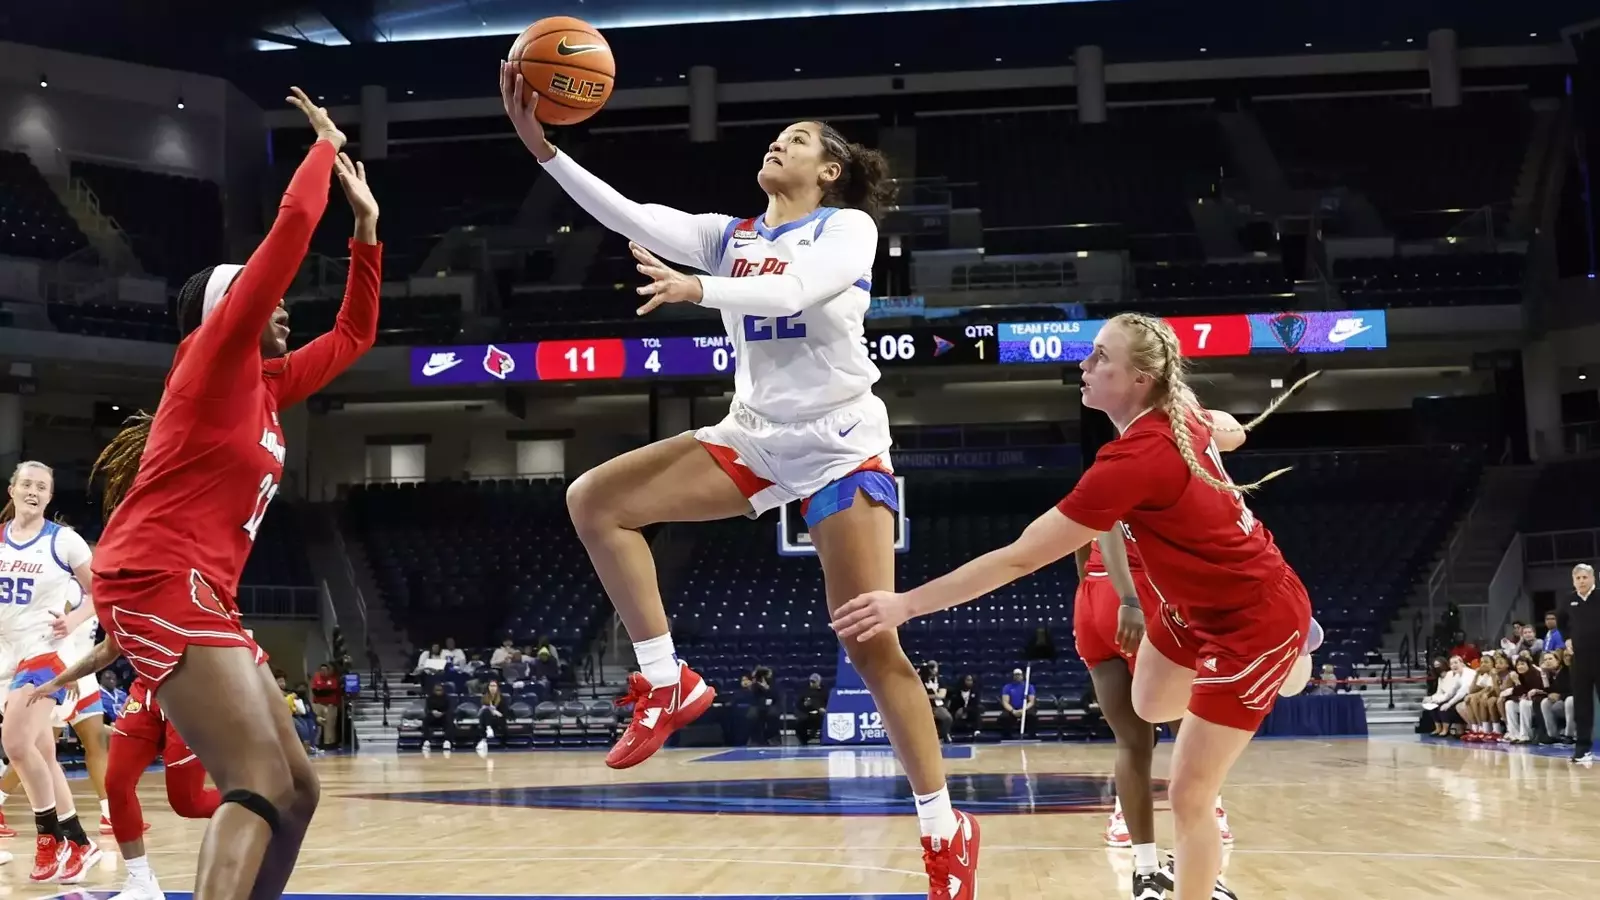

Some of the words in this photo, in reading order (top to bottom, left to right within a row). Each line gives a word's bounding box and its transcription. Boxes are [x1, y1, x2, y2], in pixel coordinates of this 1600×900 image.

[549, 72, 605, 98] ELITE
[965, 325, 994, 338] QTR
[1010, 324, 1042, 334] TEAM
[1043, 322, 1080, 334] FOULS
[1193, 323, 1212, 349] 7
[641, 338, 662, 348] TOL
[692, 336, 724, 348] TEAM
[860, 334, 915, 360] :06
[974, 340, 985, 360] 1
[1029, 336, 1062, 359] 00
[564, 347, 595, 373] 11
[644, 350, 662, 373] 4
[10, 560, 44, 574] PAUL
[0, 577, 34, 604] 35
[858, 711, 883, 729] 12
[859, 729, 889, 741] year
